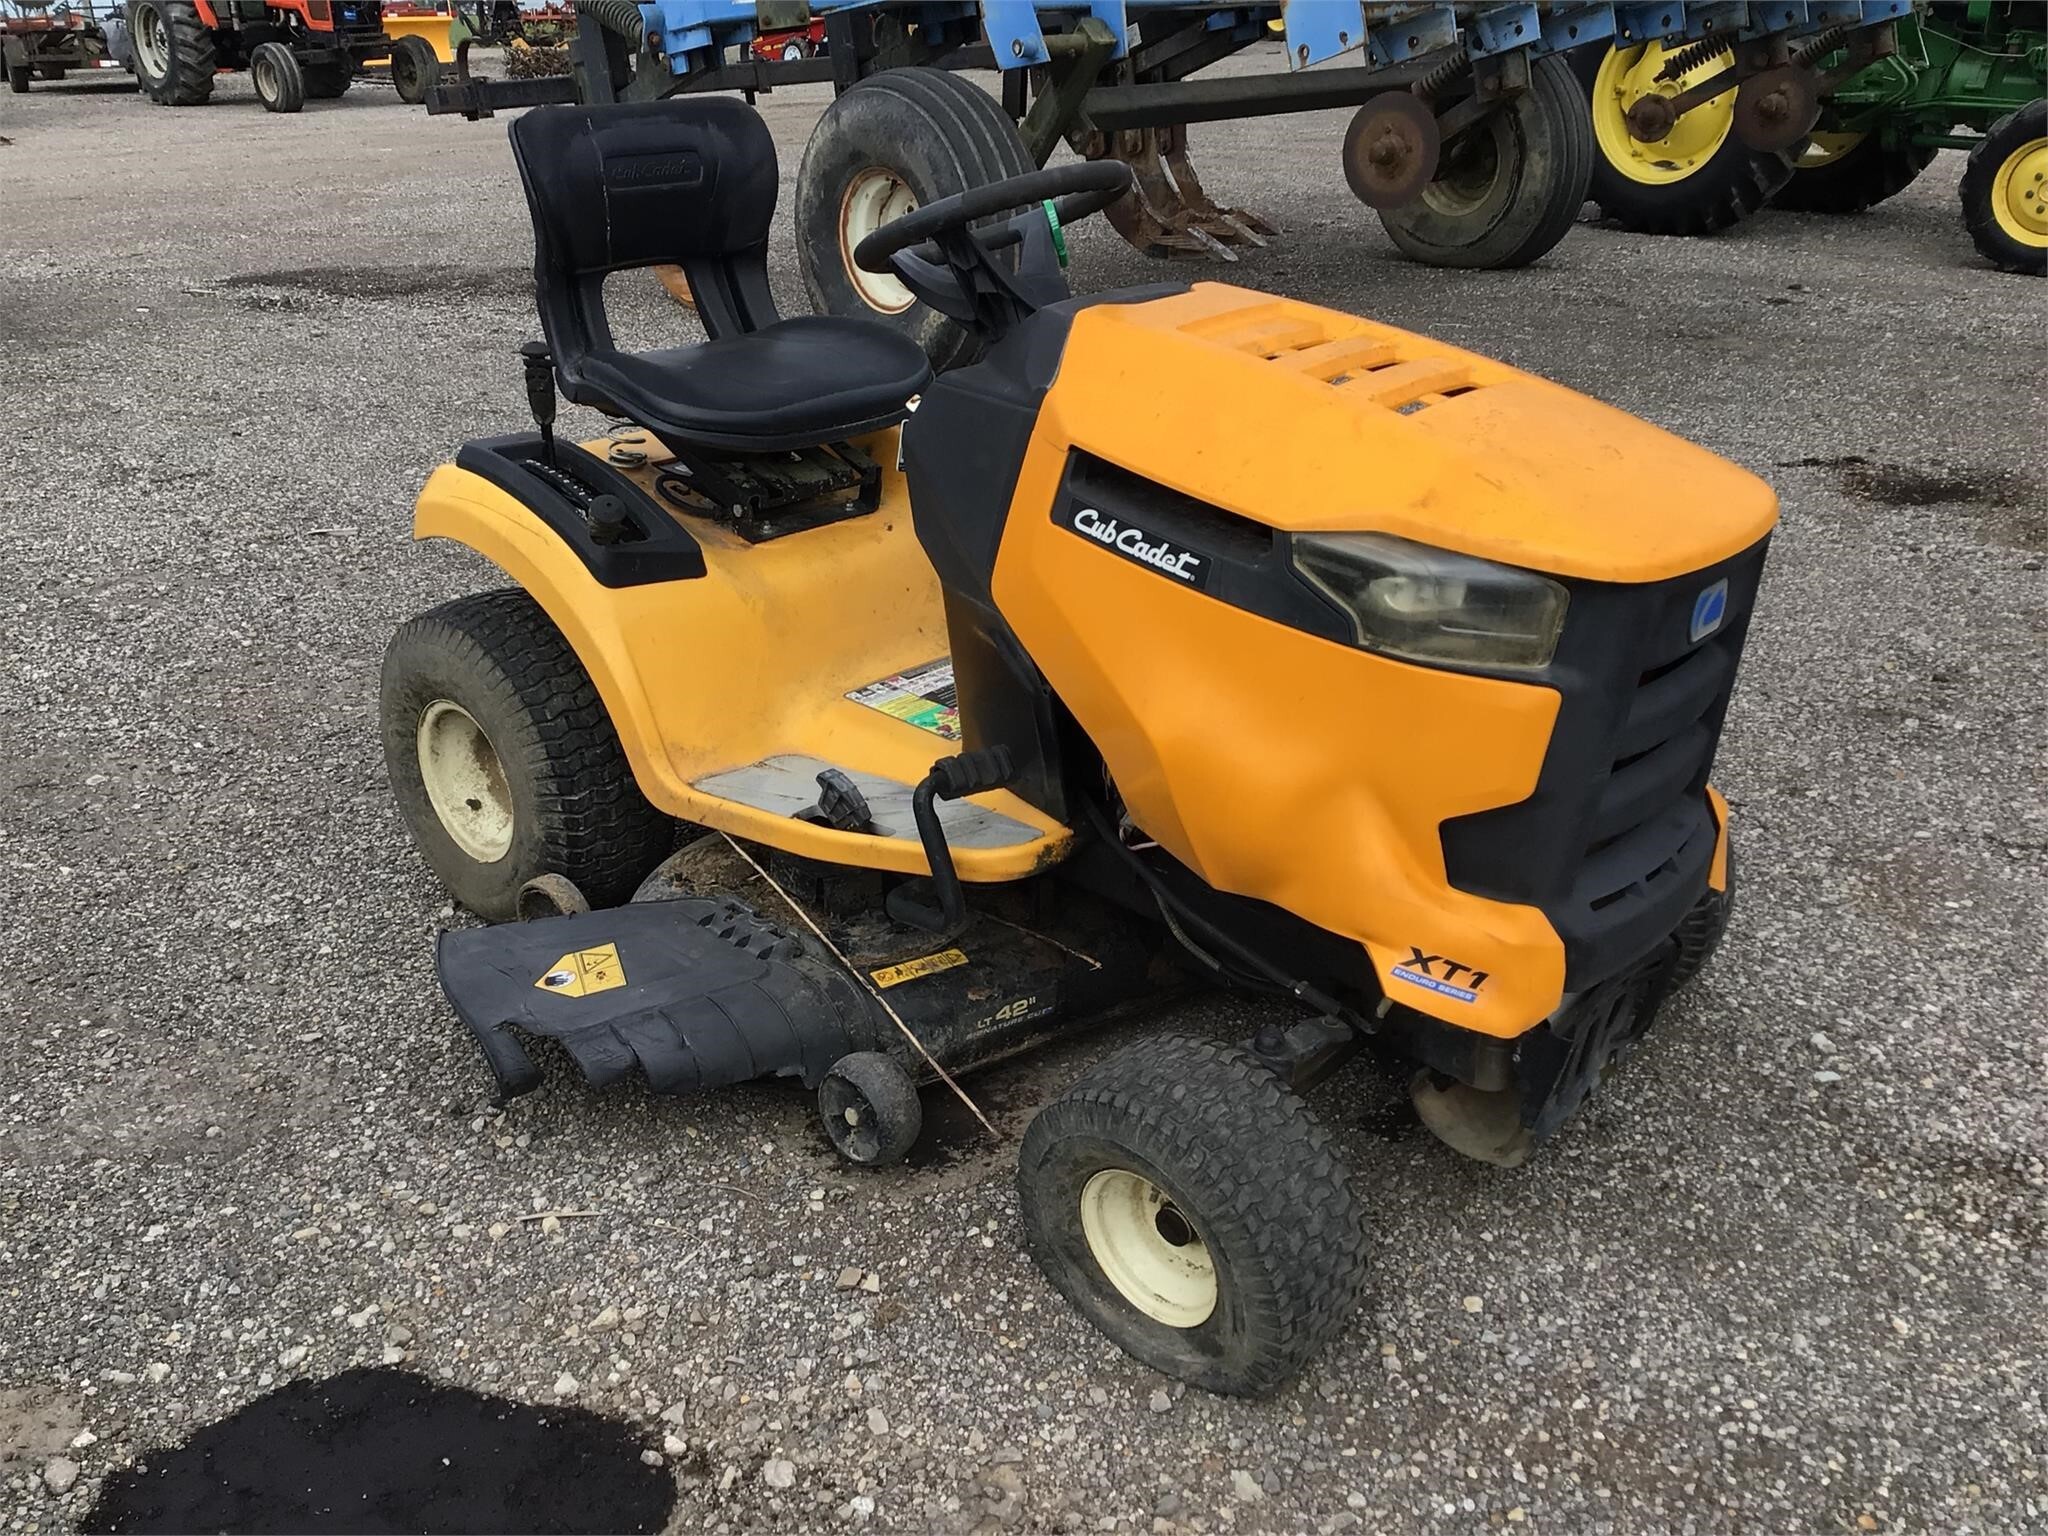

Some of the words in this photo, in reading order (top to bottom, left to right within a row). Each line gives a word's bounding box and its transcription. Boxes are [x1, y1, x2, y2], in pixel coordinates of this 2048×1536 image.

[1074, 508, 1118, 544] Cub
[1116, 528, 1200, 581] Cadet
[1393, 967, 1437, 989] ENDURO
[1437, 983, 1474, 1001] SERIES
[1398, 945, 1490, 990] XT1
[977, 1016, 993, 1029] LT
[995, 996, 1036, 1021] 42"
